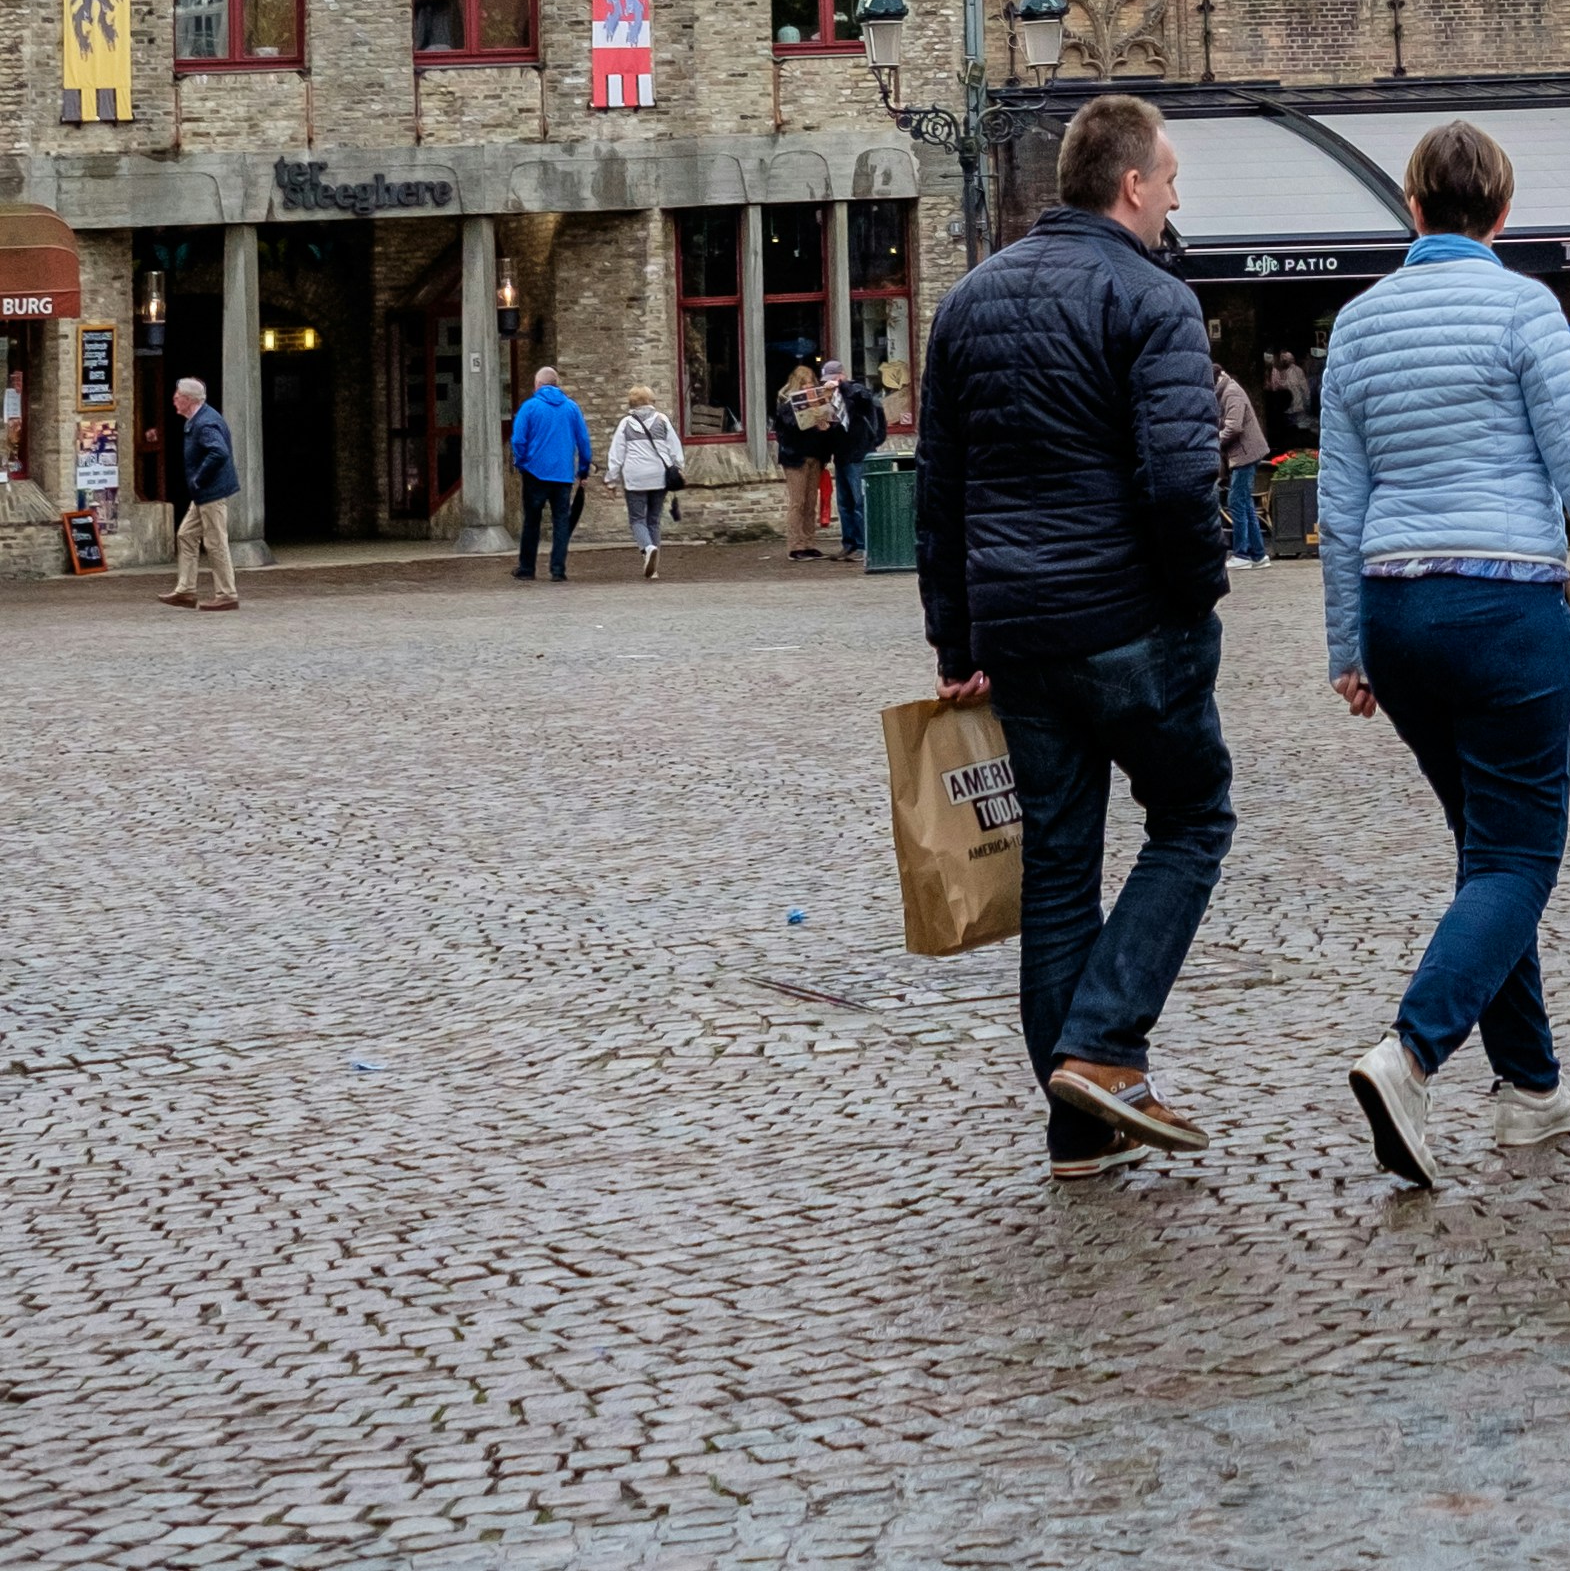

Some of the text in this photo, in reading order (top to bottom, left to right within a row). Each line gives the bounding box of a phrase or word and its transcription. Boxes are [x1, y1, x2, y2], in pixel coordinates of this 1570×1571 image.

[274, 155, 328, 188] ter
[283, 174, 453, 216] steeghere
[1244, 255, 1337, 276] Leffe PATIO
[2, 297, 52, 315] BURG
[950, 760, 1012, 801] AMERI
[977, 792, 1022, 827] TODA
